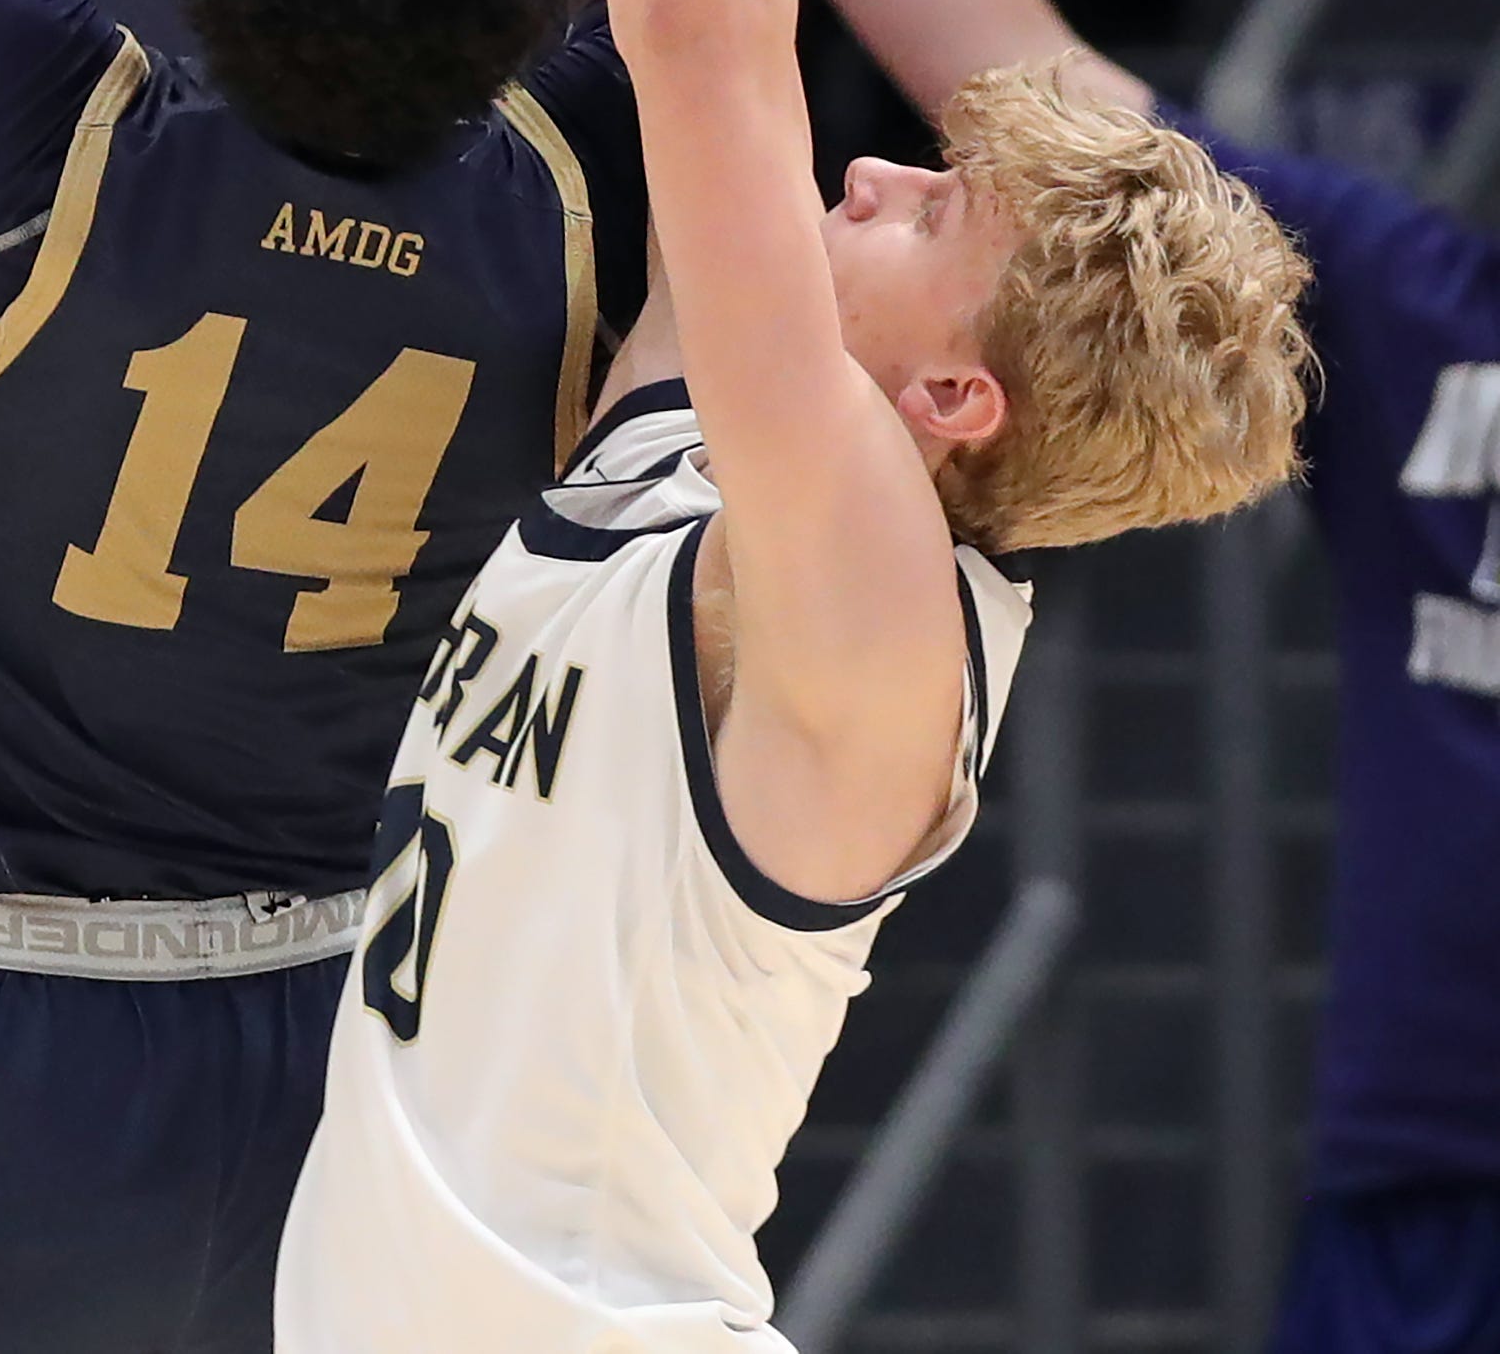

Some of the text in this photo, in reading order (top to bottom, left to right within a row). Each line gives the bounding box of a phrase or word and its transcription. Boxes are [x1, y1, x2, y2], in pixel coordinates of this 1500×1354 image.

[260, 201, 424, 277] AMDG
[52, 311, 477, 653] 14
[417, 609, 587, 803] RAN
